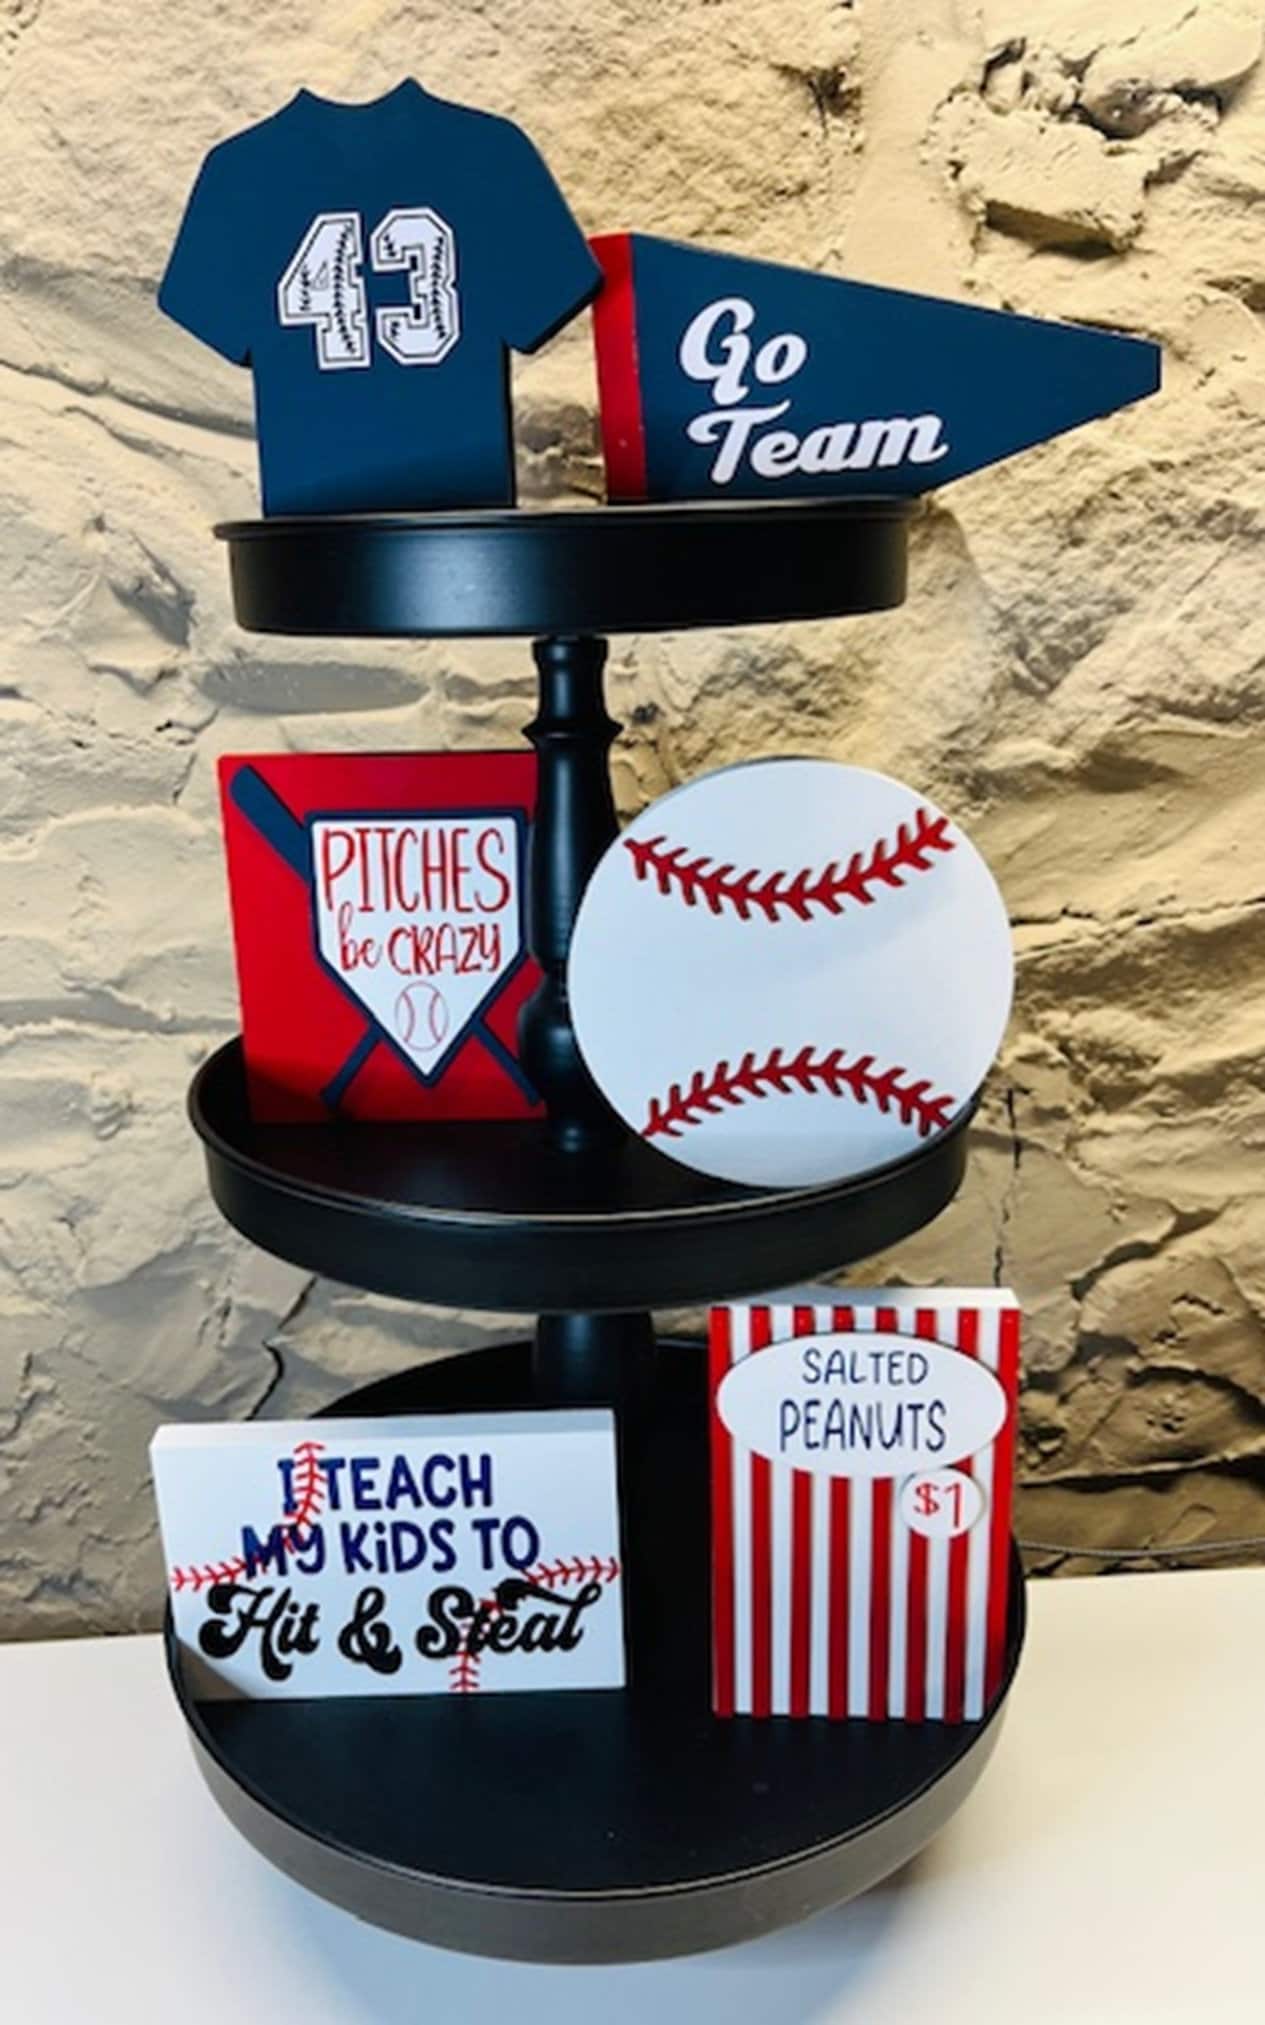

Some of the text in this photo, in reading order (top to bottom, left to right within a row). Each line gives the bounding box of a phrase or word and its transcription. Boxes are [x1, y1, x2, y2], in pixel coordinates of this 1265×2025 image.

[277, 205, 461, 370] 43
[680, 297, 807, 406] Go
[686, 399, 949, 485] Team
[321, 827, 511, 913] PITCHES
[337, 901, 501, 976] be CRAZY
[802, 1347, 929, 1385] SALTED
[779, 1398, 947, 1452] PEANUTS
[277, 1453, 493, 1515] I TEACH
[913, 1481, 964, 1529] $1
[471, 1516, 540, 1572] TO
[199, 1578, 602, 1682] Hit & Steal
